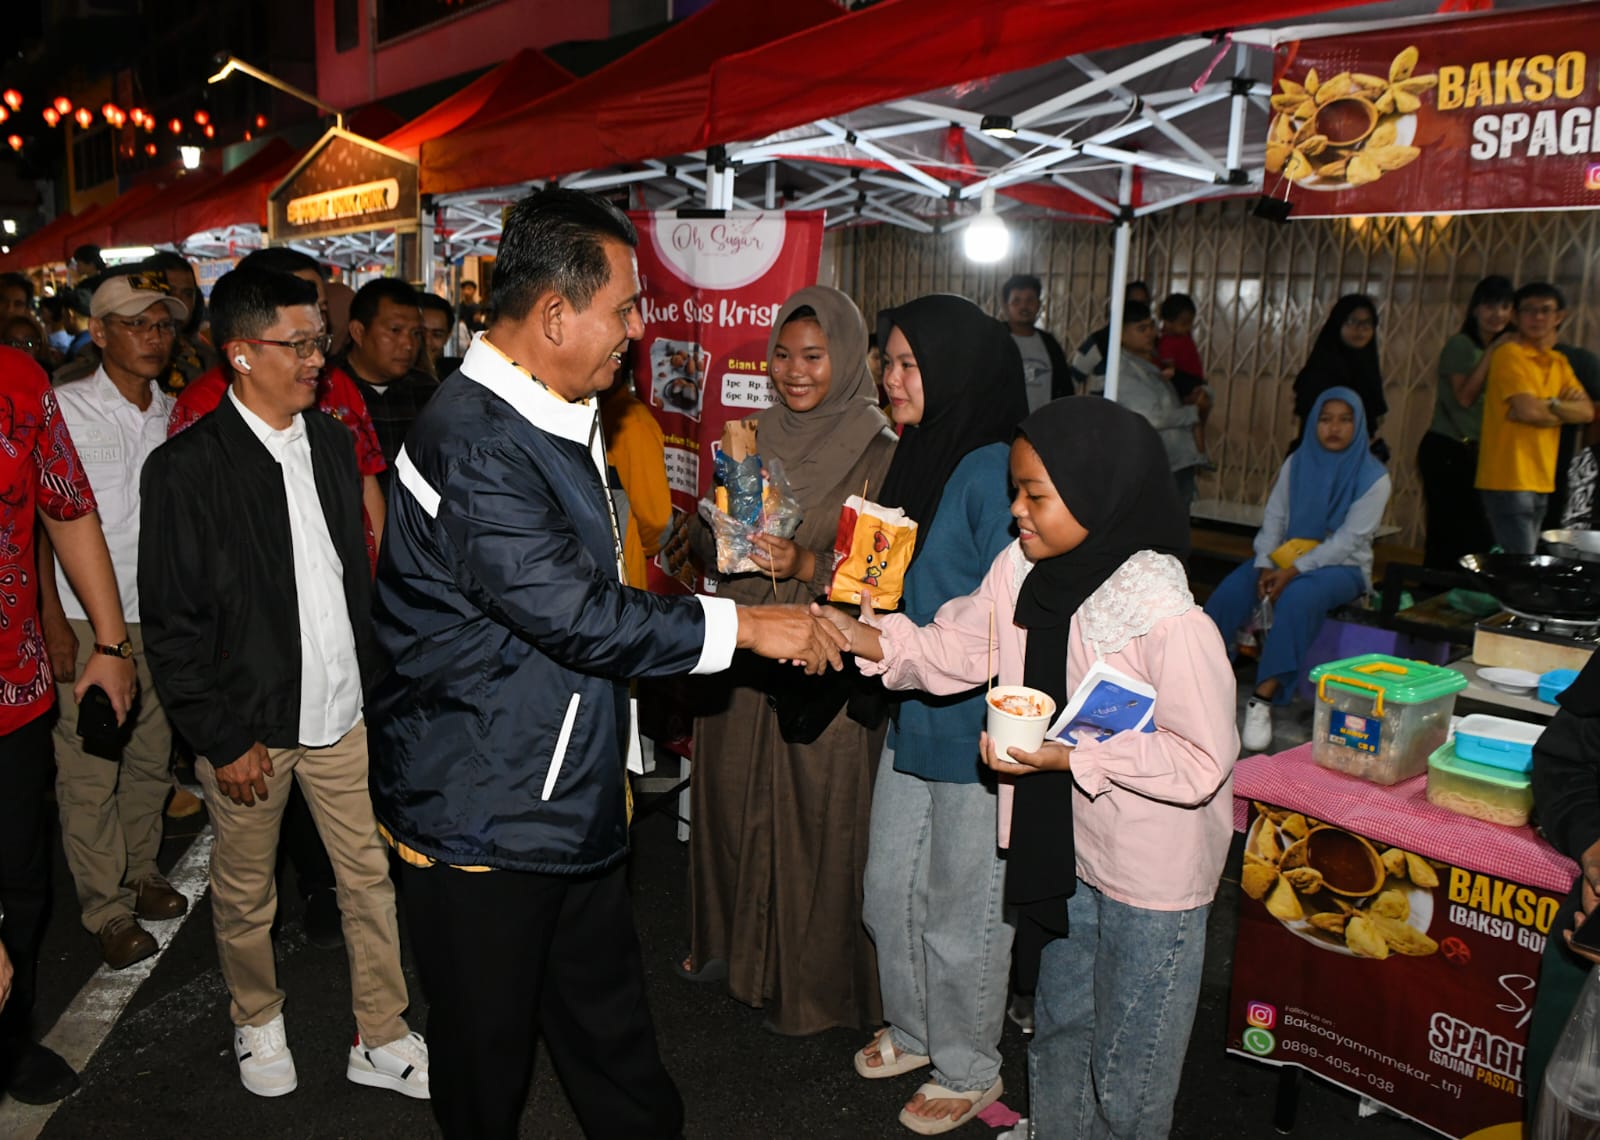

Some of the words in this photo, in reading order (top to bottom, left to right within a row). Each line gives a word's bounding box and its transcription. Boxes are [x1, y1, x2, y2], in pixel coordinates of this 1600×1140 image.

[1438, 51, 1586, 111] BAKSO
[672, 223, 704, 252] Oh
[710, 224, 764, 255] Sugar
[640, 297, 679, 325] Kue
[683, 298, 714, 324] Sus
[1448, 866, 1561, 935] BAKSO
[1449, 904, 1515, 941] (BAKSO
[1496, 973, 1536, 1029] S
[1281, 1039, 1395, 1094] 0899-4054-038
[1476, 1067, 1516, 1095] PASTA
